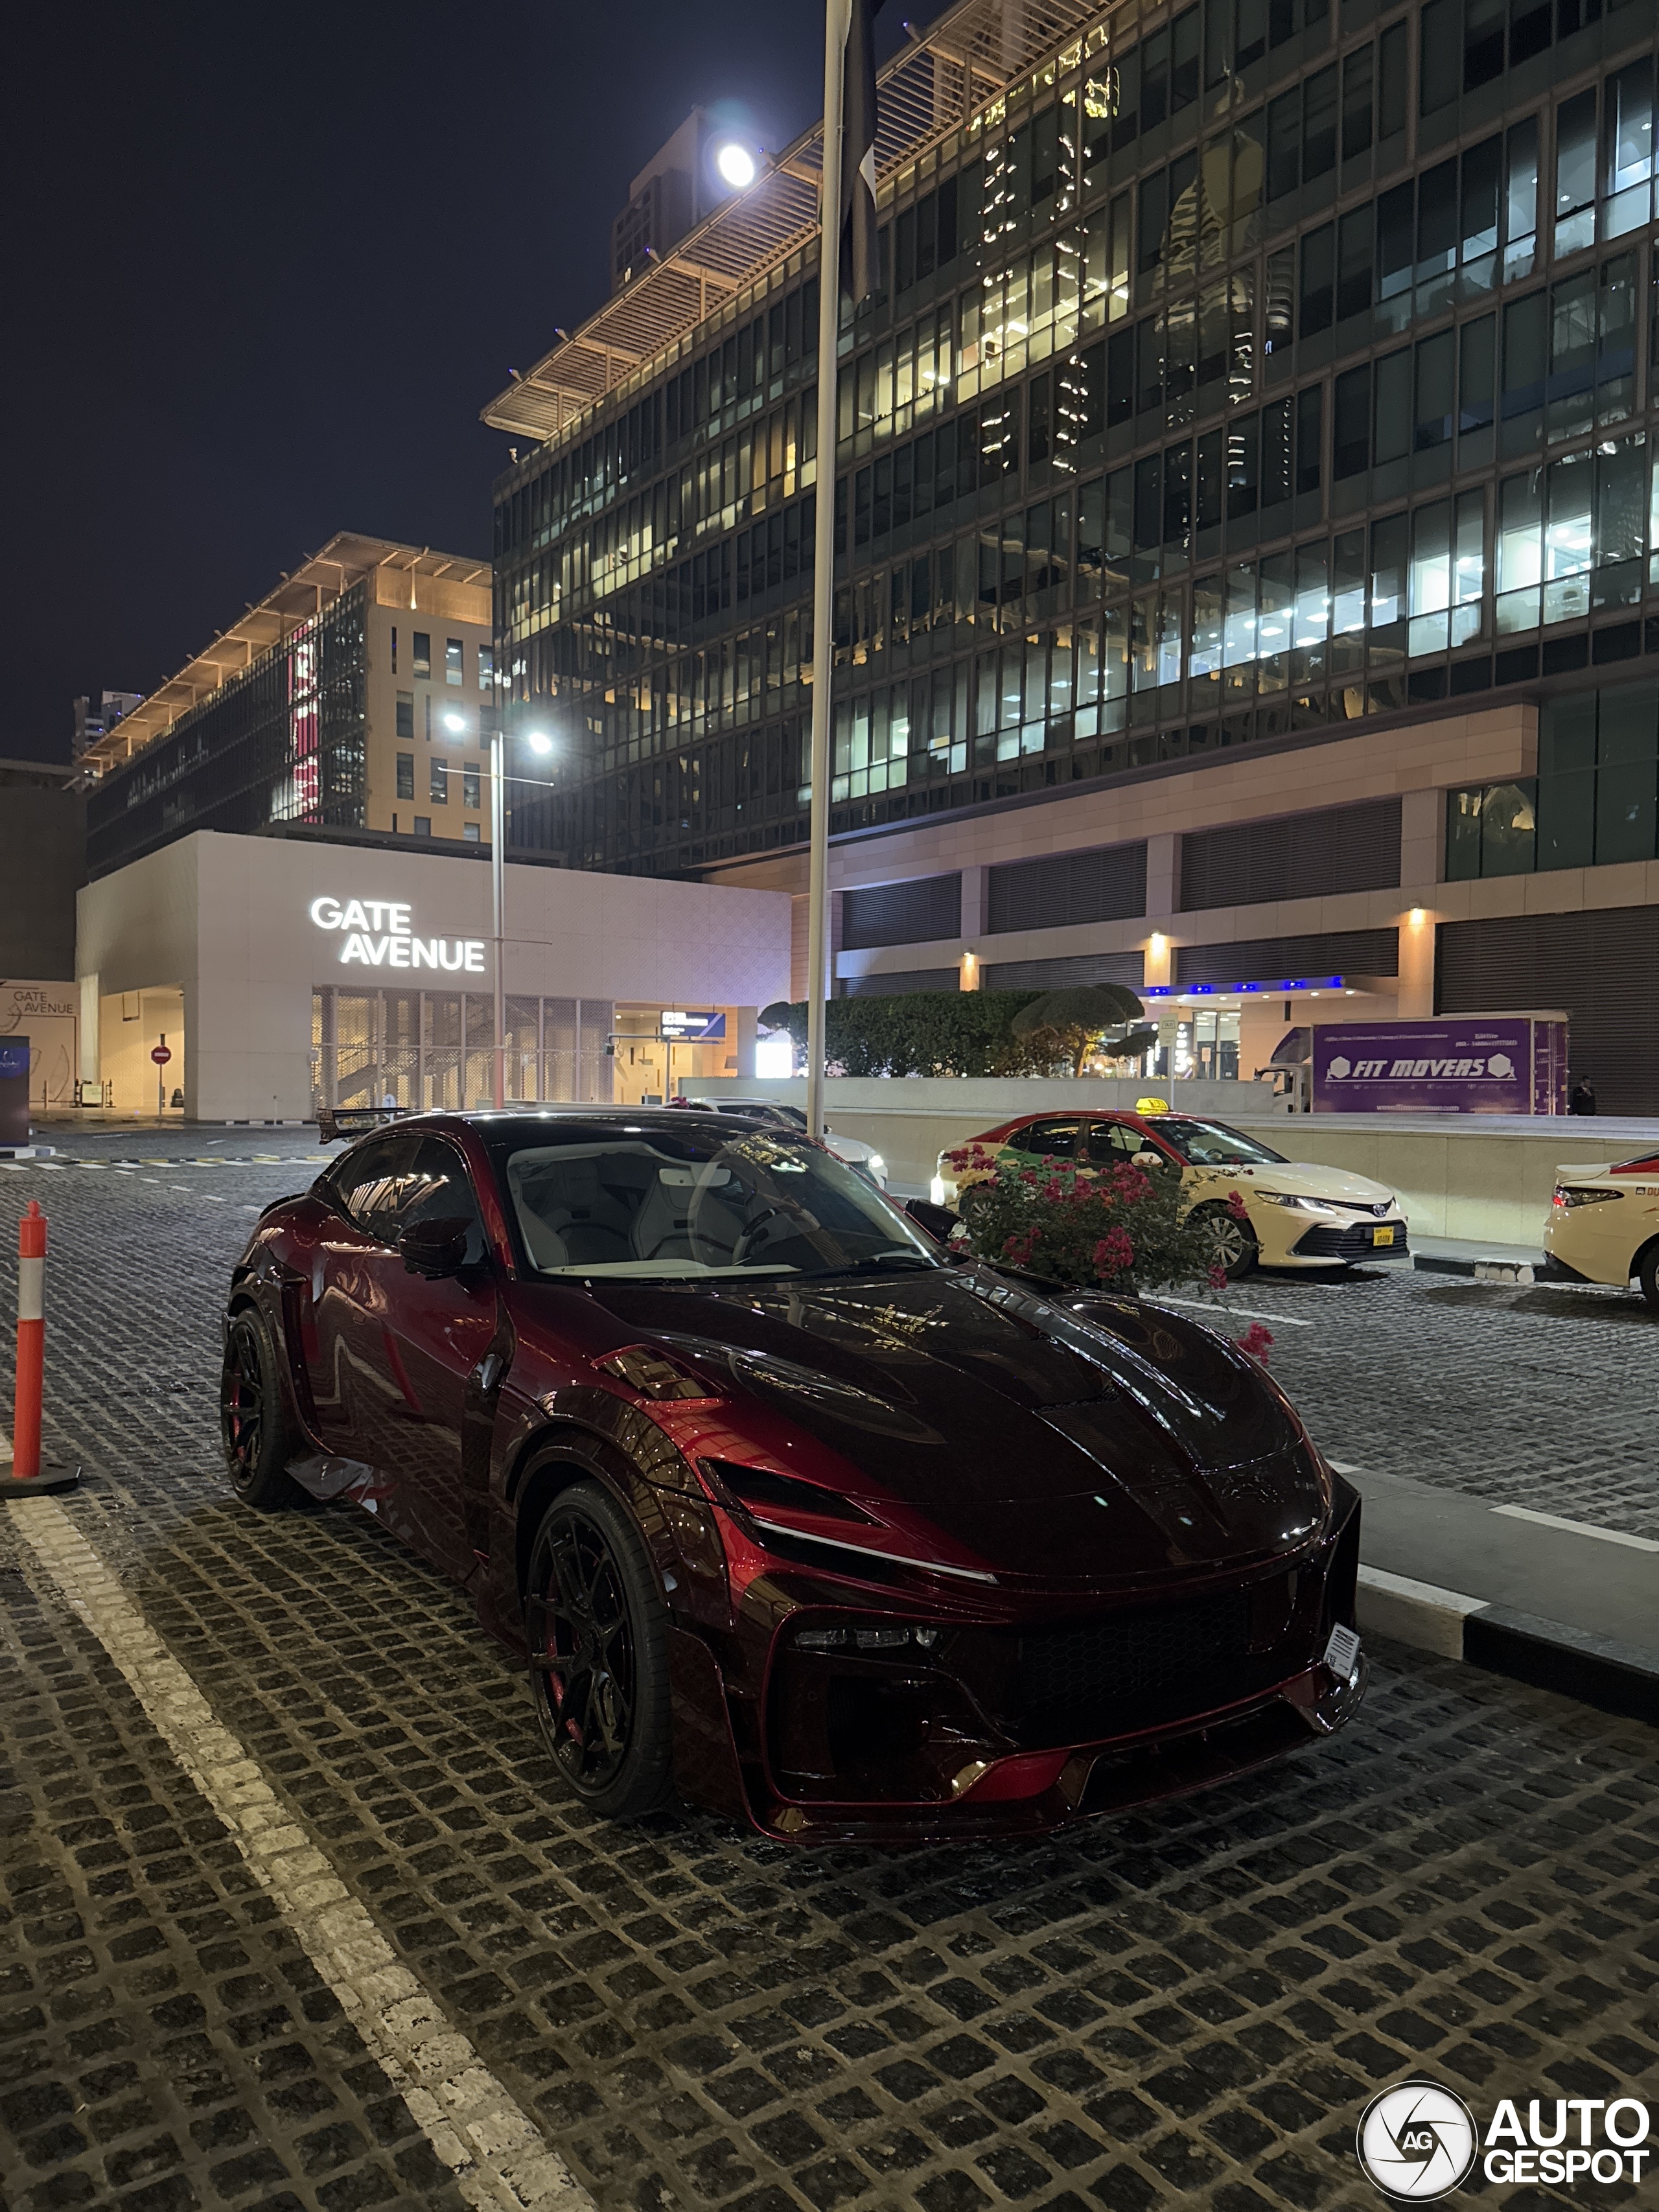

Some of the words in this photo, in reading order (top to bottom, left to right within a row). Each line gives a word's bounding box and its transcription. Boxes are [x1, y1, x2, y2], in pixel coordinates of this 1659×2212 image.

[311, 897, 412, 935] GATE
[340, 934, 485, 972] AVENUE
[14, 991, 47, 1002] GATE
[24, 1003, 74, 1014] AVENUE
[1352, 1060, 1388, 1077] FIT
[1389, 1058, 1487, 1077] MOVERS
